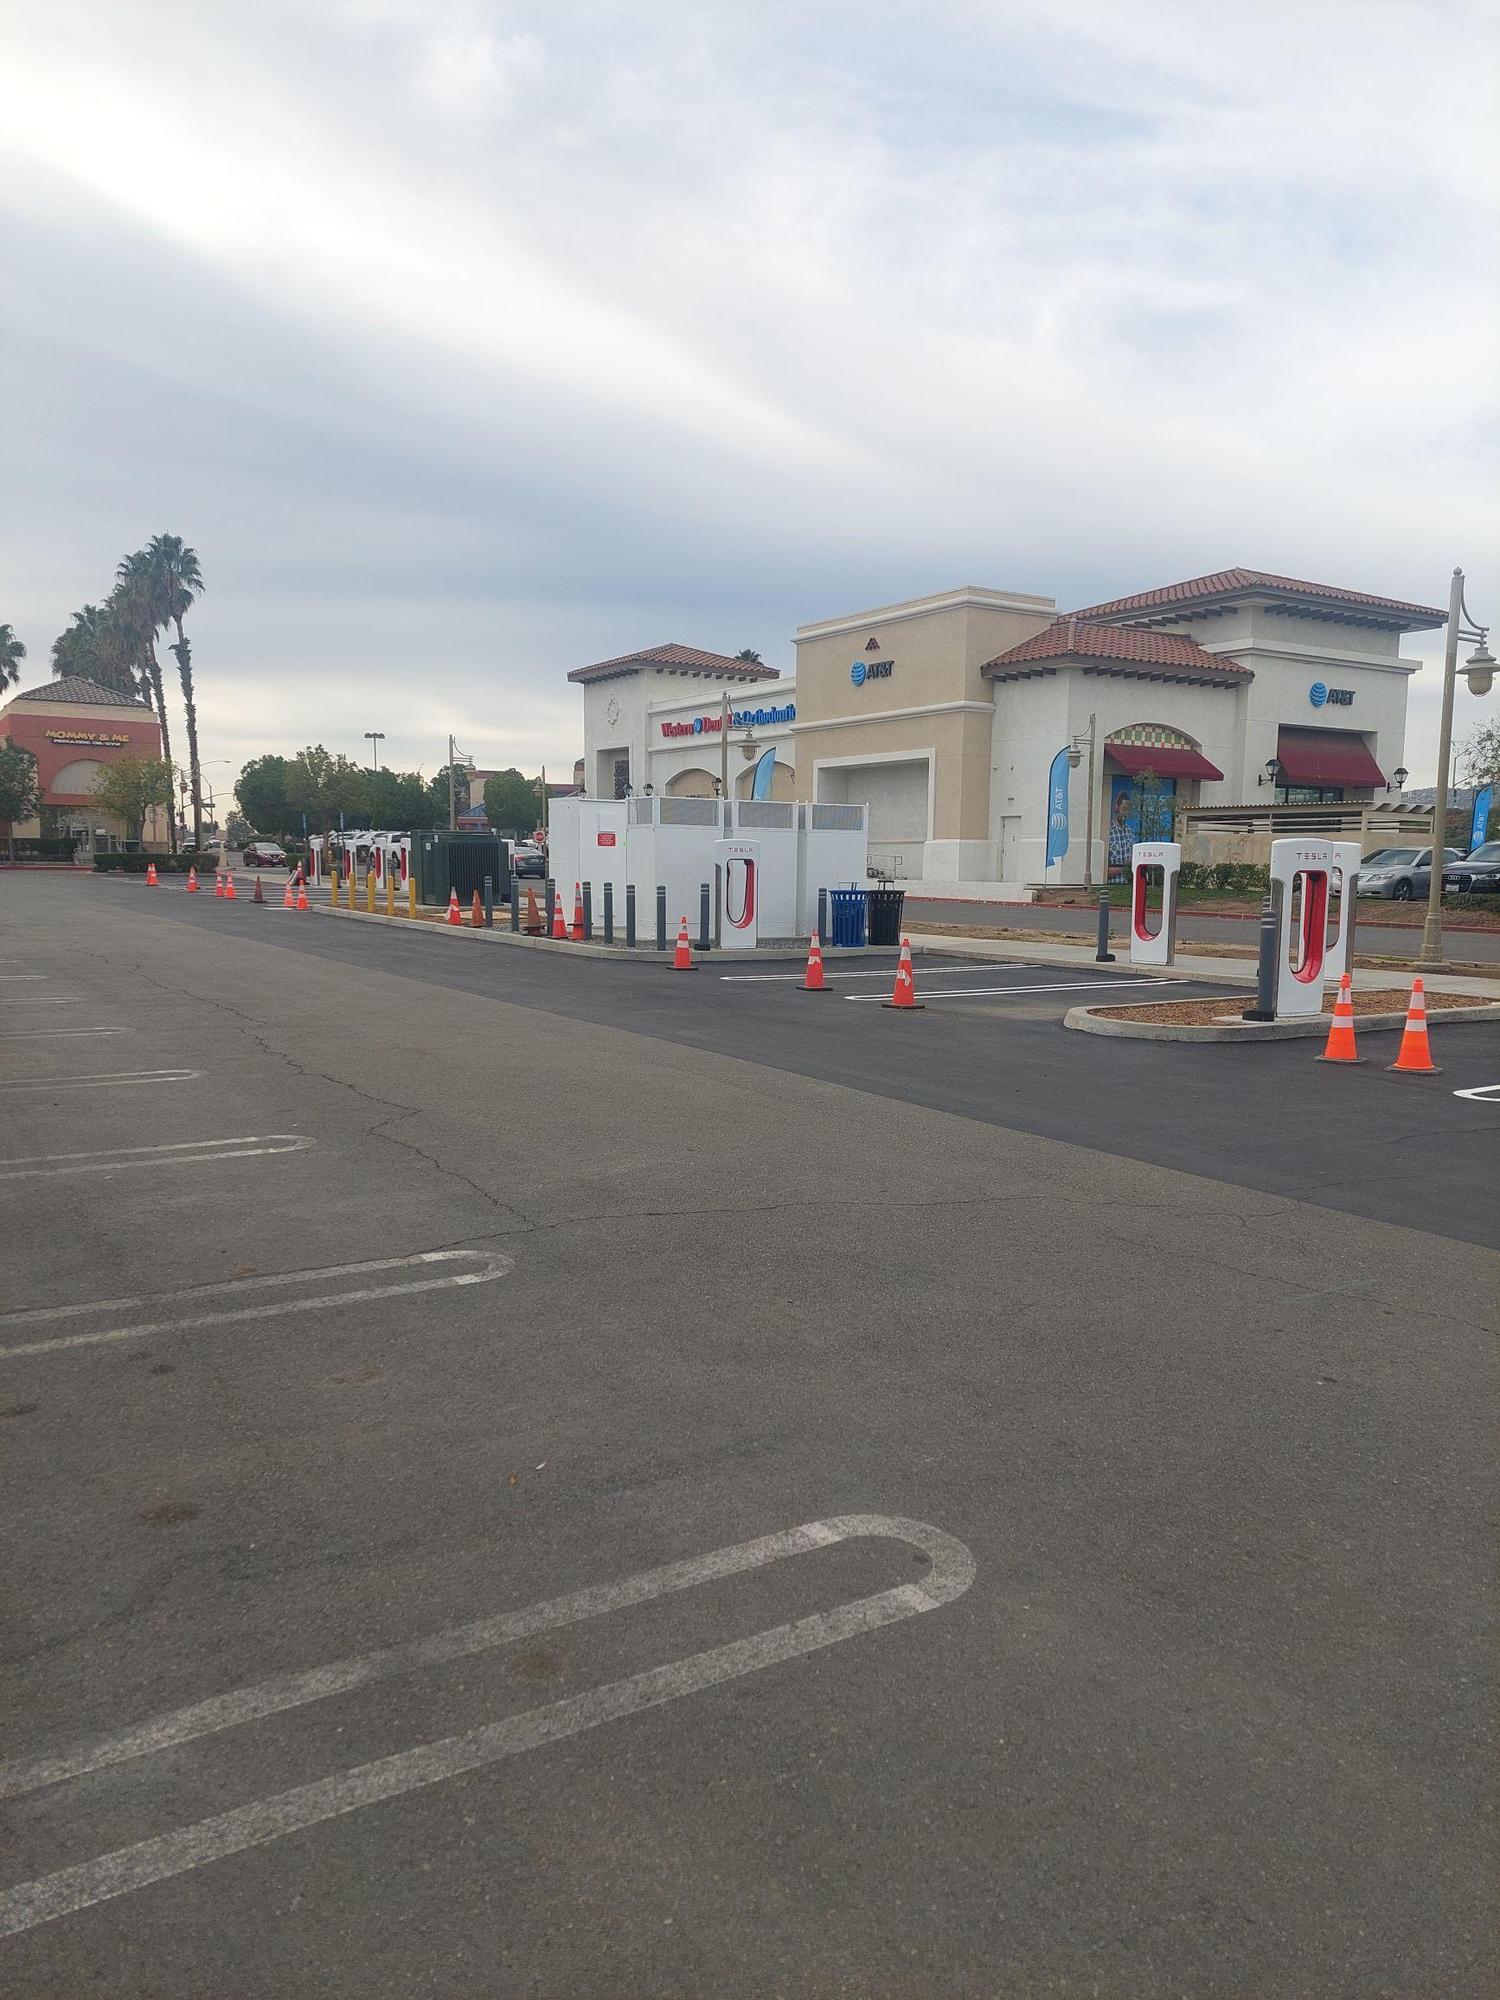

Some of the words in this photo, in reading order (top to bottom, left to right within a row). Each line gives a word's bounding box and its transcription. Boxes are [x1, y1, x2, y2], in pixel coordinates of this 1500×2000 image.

[866, 660, 895, 680] AT&T
[1326, 688, 1356, 706] AT&T
[45, 729, 97, 741] MOMMY
[99, 733, 109, 741] &
[111, 734, 129, 742] ME
[661, 721, 694, 738] Western
[1055, 787, 1064, 810] AT&T
[1296, 852, 1328, 860] TESLA
